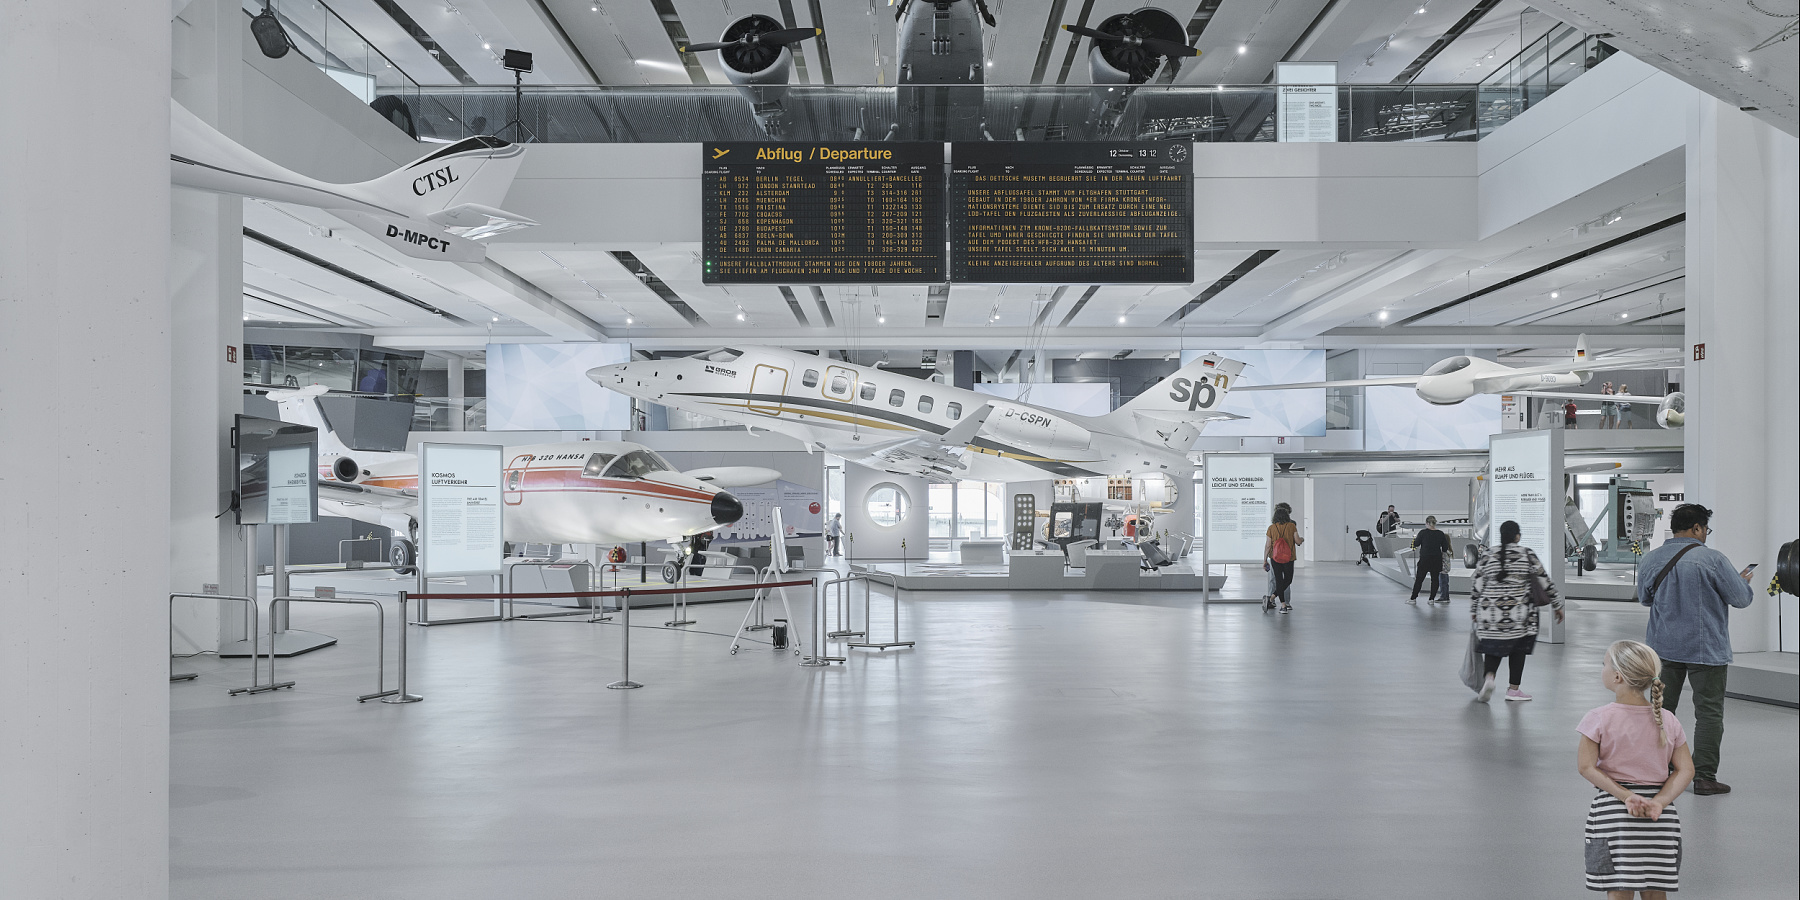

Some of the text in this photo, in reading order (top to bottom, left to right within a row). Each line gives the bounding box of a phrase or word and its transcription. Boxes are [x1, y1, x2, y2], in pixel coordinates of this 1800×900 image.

[756, 148, 802, 162] Abflug
[820, 147, 892, 162] Departure
[412, 165, 459, 196] CTSL
[386, 224, 450, 253] D-MPCT
[715, 367, 737, 376] GROB
[1005, 408, 1052, 427] D-CSPN
